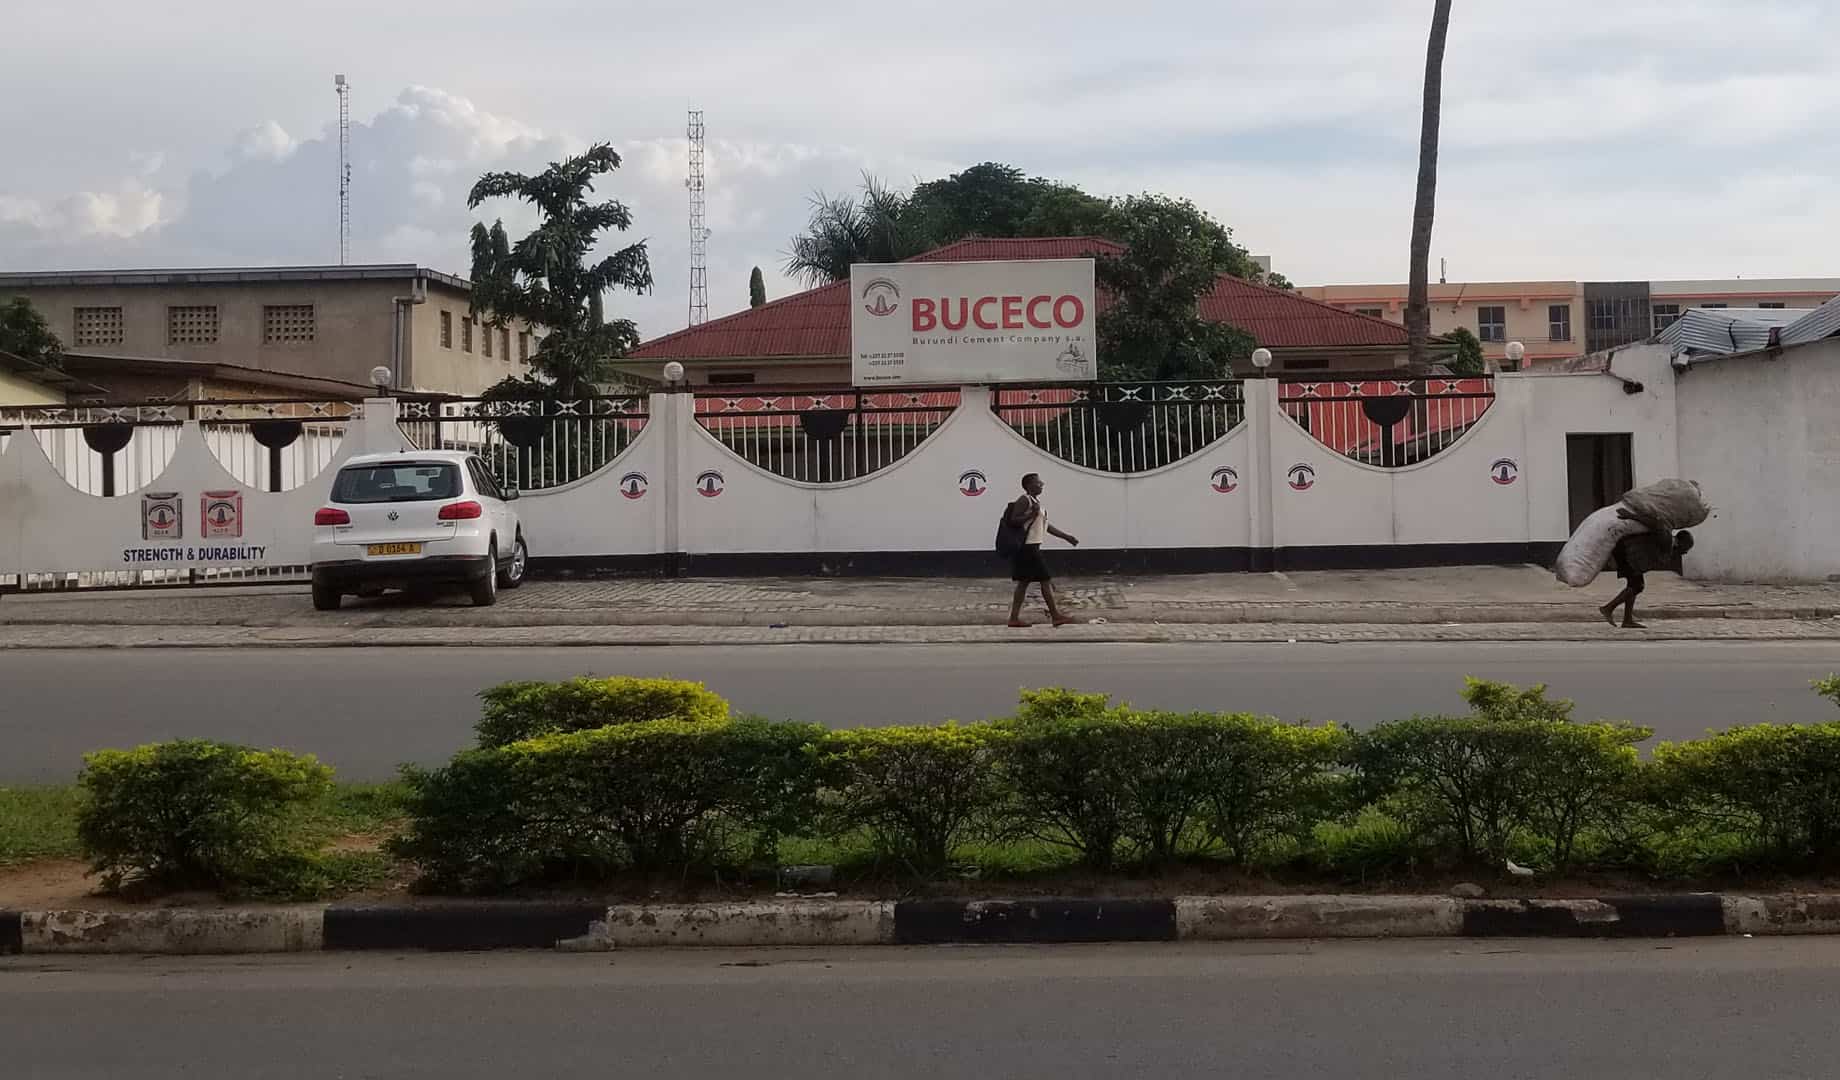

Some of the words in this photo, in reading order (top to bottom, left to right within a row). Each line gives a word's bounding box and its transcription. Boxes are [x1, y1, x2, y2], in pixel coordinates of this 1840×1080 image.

[912, 294, 1085, 332] BUCECO
[912, 336, 958, 345] Burundi
[962, 336, 1004, 344] Cement
[1009, 335, 1061, 345] Company
[123, 547, 183, 562] STRENGTH
[187, 548, 195, 560] &
[198, 546, 266, 561] DURABILITY
